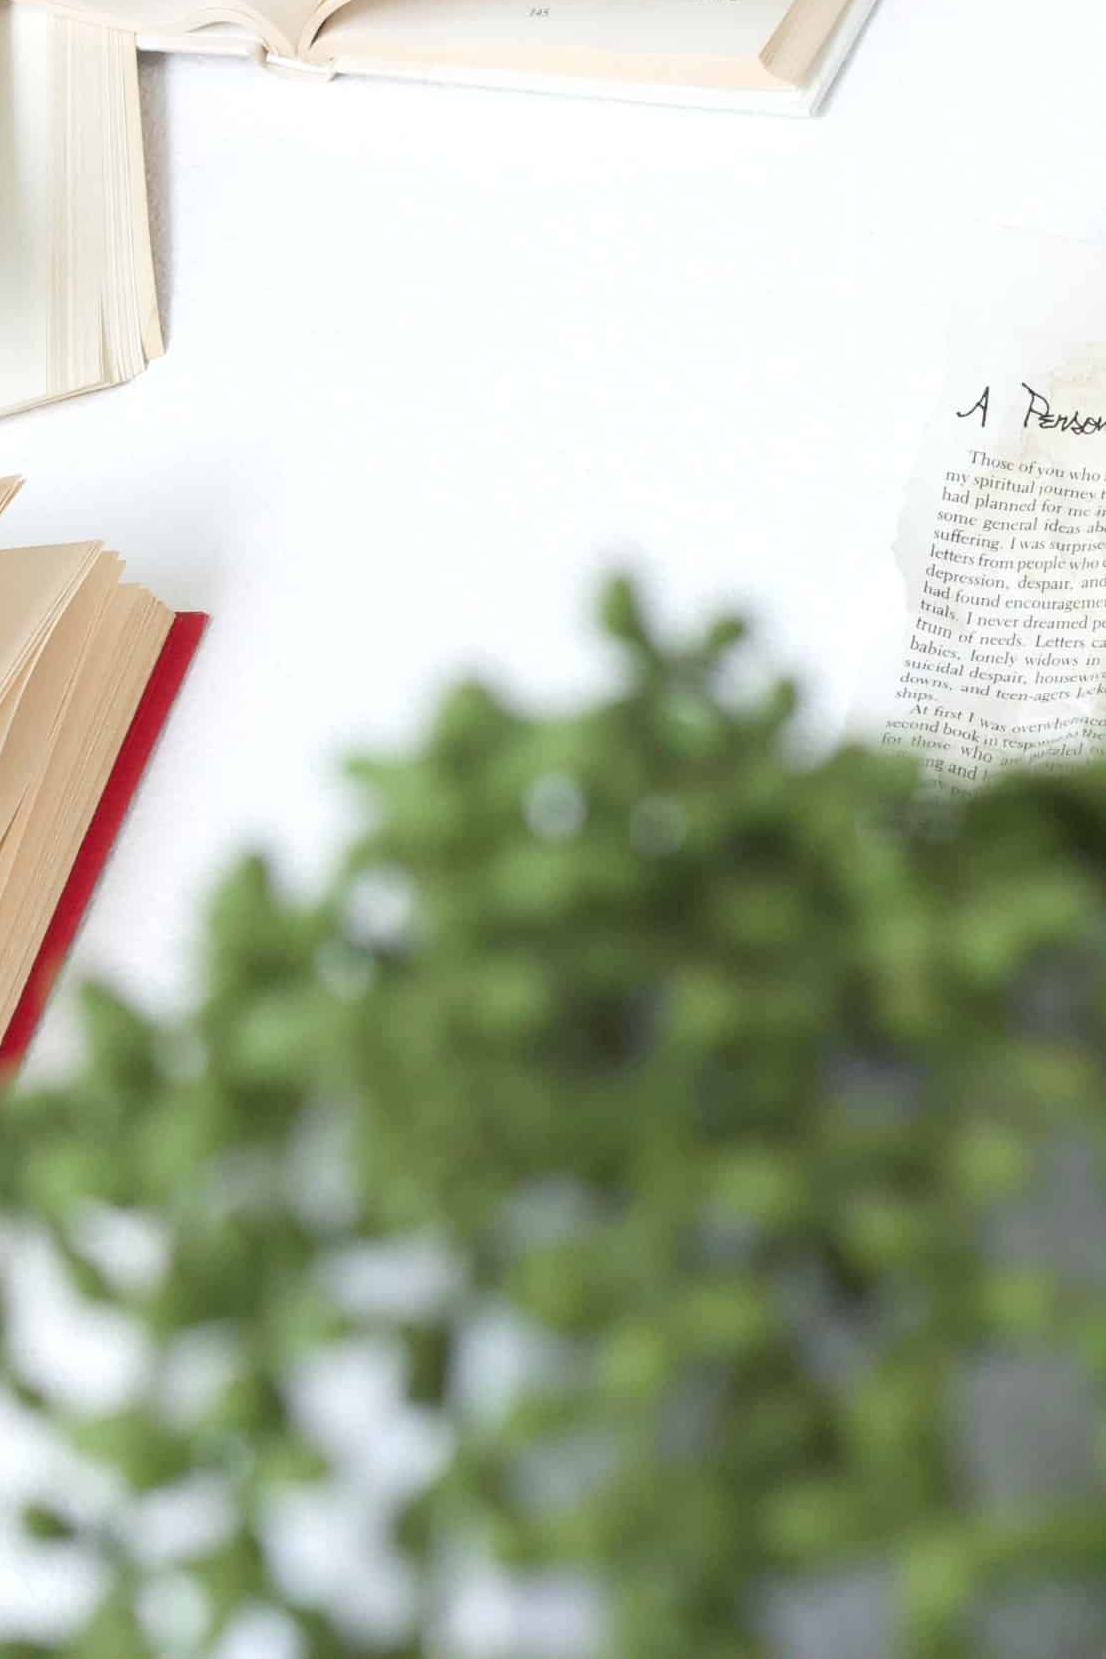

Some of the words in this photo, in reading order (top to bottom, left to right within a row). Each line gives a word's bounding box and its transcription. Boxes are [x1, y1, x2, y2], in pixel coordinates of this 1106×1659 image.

[956, 386, 989, 427] A
[967, 449, 1014, 471] Those
[1019, 461, 1036, 474] of
[1036, 466, 1064, 479] you
[1069, 468, 1101, 482] who
[945, 471, 969, 486] my
[973, 474, 1035, 494] spiritual
[1039, 481, 1095, 500] journey
[942, 486, 970, 505] had
[974, 495, 1037, 513] planned
[1041, 500, 1062, 515] for
[1068, 507, 1091, 517] me
[937, 510, 978, 526] some
[982, 517, 1038, 532] general
[1044, 519, 1081, 534] ideas
[933, 528, 1003, 552] suffering.
[1009, 537, 1015, 550] I
[1019, 541, 1045, 550] was
[929, 543, 975, 566] letters
[978, 554, 1014, 569] from
[1017, 557, 1066, 573] people
[1069, 557, 1100, 570] who
[923, 581, 951, 599] had
[956, 590, 1000, 608] found
[920, 599, 959, 621] trials.
[966, 611, 973, 625] I
[977, 617, 1020, 628] never
[1023, 615, 1089, 630] dreamed
[916, 617, 952, 639] trum
[958, 630, 977, 644] of
[1035, 635, 1085, 649] Letters
[904, 658, 963, 677] suicidal
[970, 649, 1016, 666] lonely
[1024, 651, 1079, 666] widows
[1086, 654, 1101, 666] in
[895, 688, 937, 702] ships.
[960, 684, 991, 696] and
[996, 686, 1071, 703] teen-agers
[885, 719, 940, 734] second
[942, 723, 980, 743] book
[910, 704, 928, 716] At
[934, 705, 963, 720] first
[967, 712, 974, 723] I
[980, 718, 1006, 733] was
